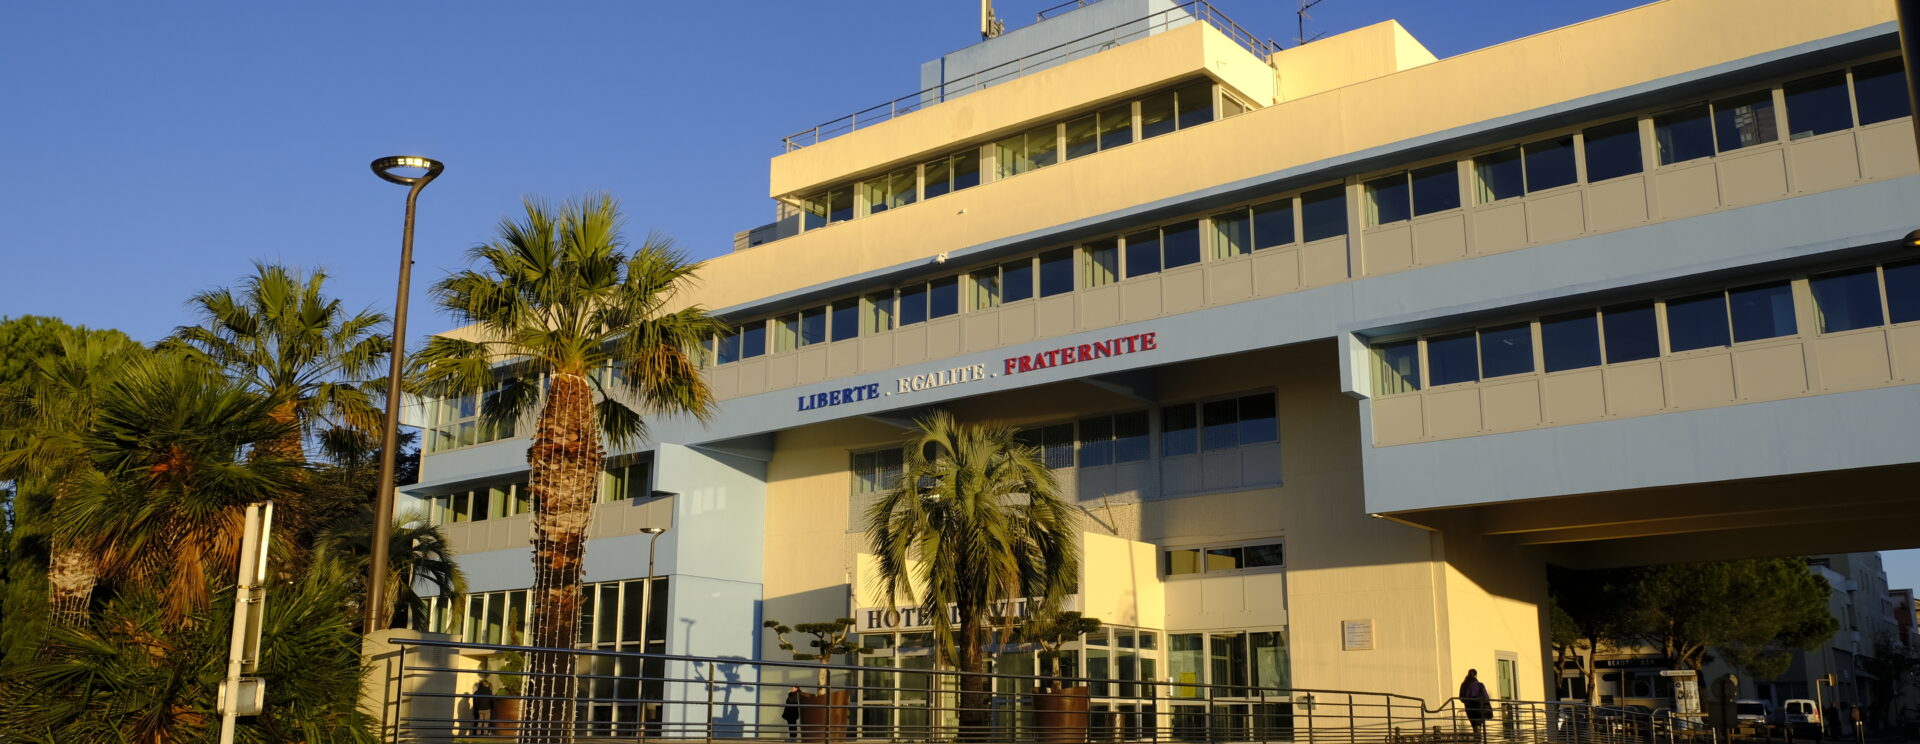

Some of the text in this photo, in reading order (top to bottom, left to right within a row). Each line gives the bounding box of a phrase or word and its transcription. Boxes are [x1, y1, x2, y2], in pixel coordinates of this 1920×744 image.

[798, 332, 1157, 412] LIBERTE EGALITE FRATERNITE
[867, 607, 943, 628] HOTE
